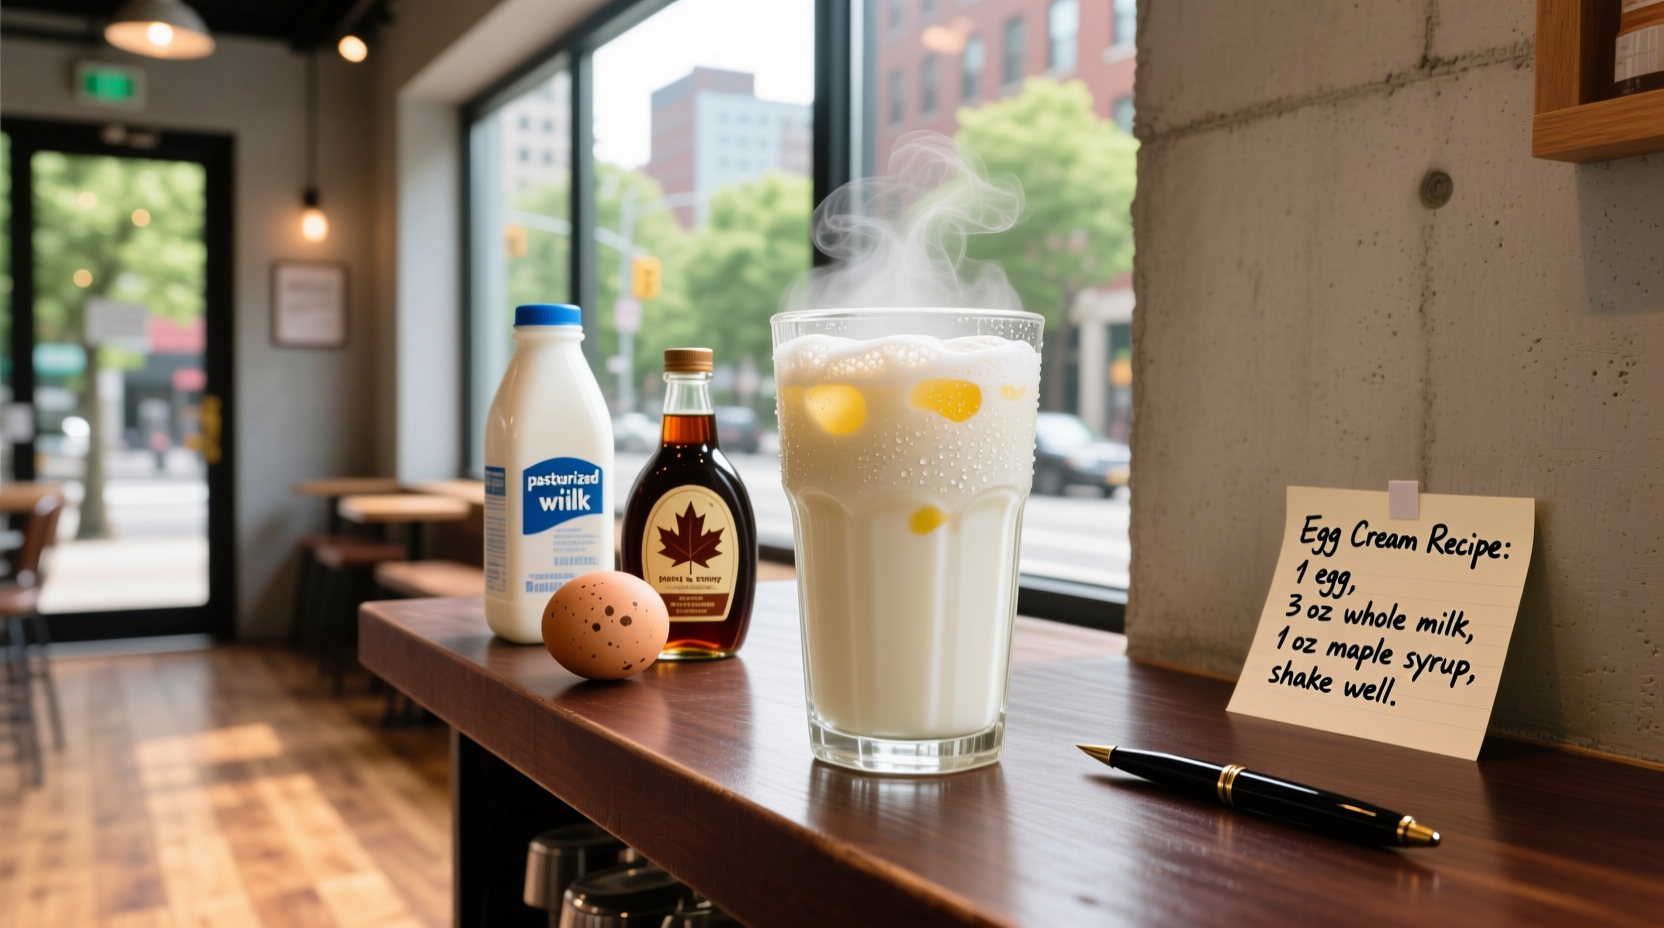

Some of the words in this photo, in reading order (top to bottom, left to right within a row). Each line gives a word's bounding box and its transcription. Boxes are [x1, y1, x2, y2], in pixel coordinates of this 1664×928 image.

[1300, 515, 1341, 557] Egg
[1350, 520, 1417, 551] Cream
[1426, 523, 1511, 569] Recipe:
[1296, 559, 1309, 584] 1
[1315, 568, 1355, 599] egg,
[1285, 593, 1302, 617] 3
[1307, 605, 1333, 621] oz
[1344, 600, 1406, 630] whole
[1416, 610, 1474, 644] milk,
[1276, 625, 1290, 649] 1
[1292, 636, 1317, 654] oz
[1326, 637, 1393, 670] maple
[1403, 651, 1475, 688] syrup,
[1268, 660, 1333, 693] shake
[1344, 676, 1396, 706] well.
